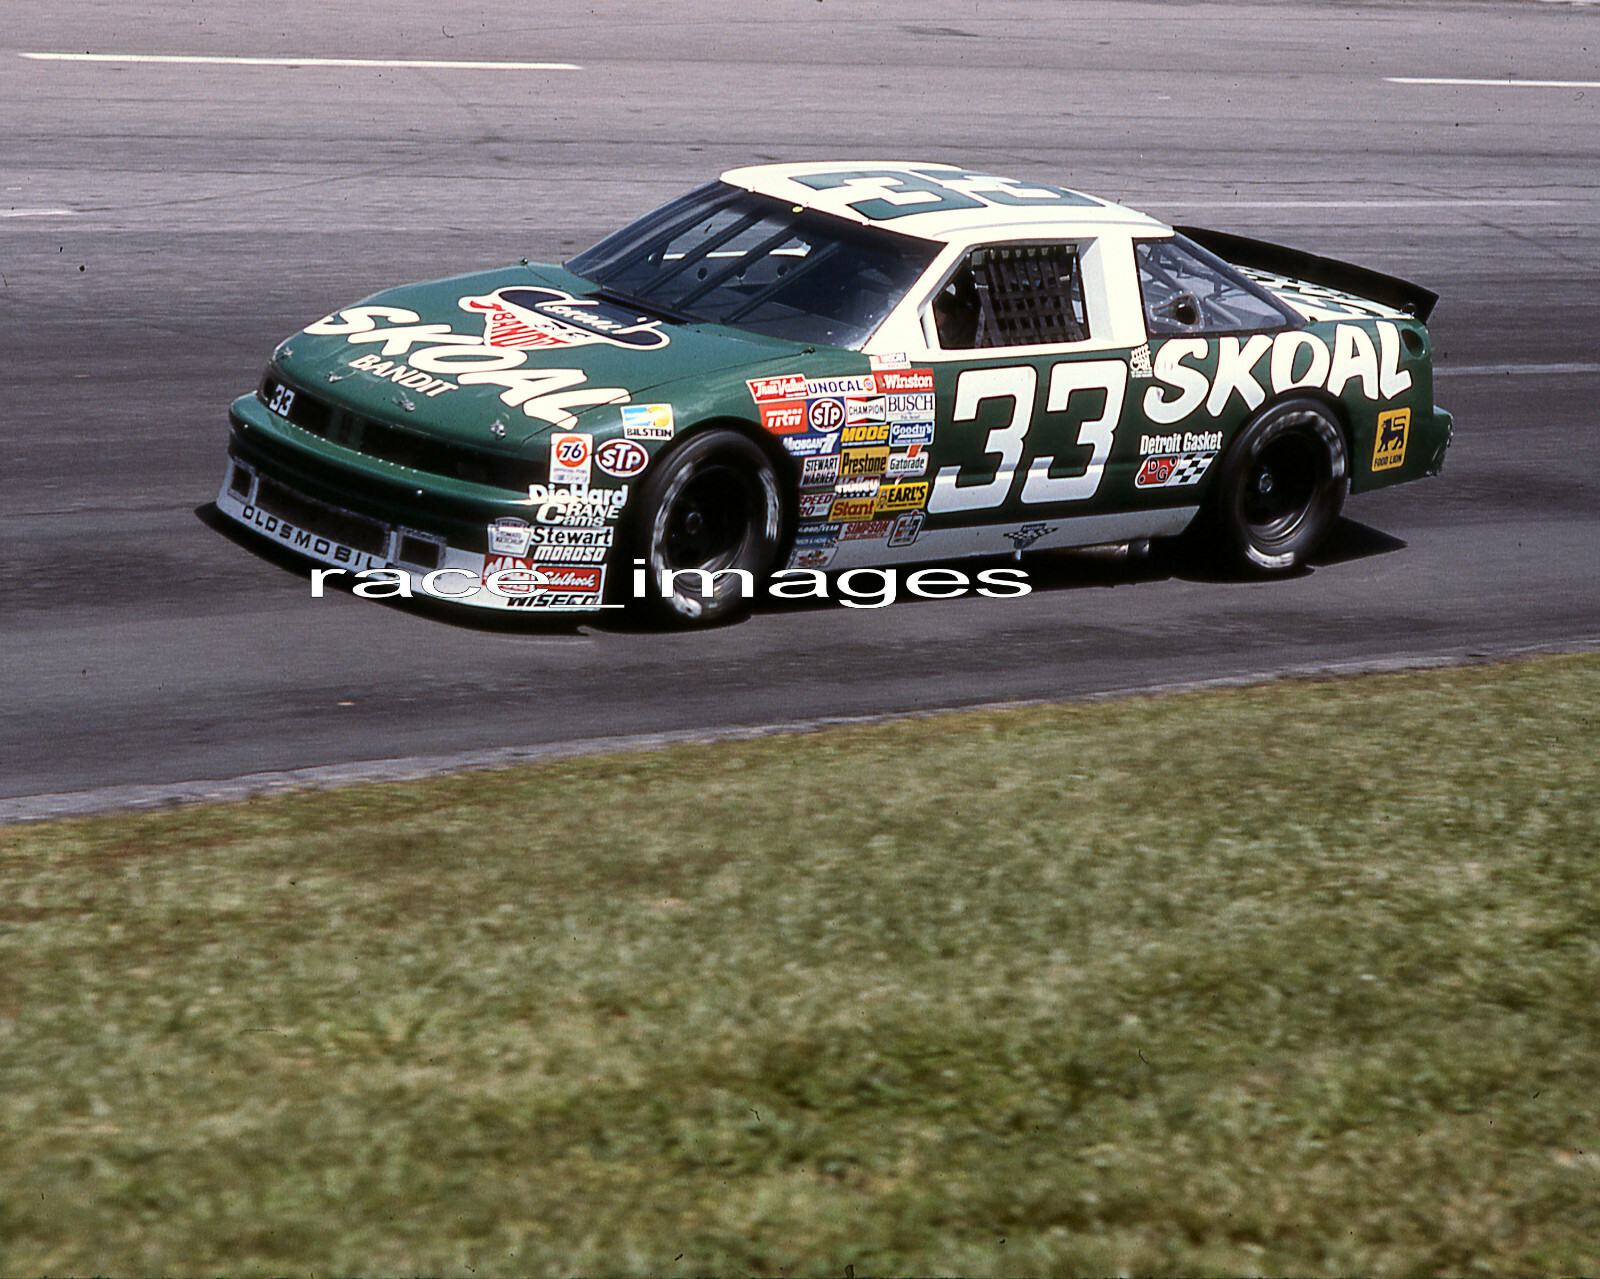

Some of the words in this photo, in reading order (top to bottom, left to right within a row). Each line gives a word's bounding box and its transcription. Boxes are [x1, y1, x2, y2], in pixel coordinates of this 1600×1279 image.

[788, 169, 1106, 221] 33
[303, 305, 632, 430] SKOAL
[348, 353, 460, 397] BANDIT
[1142, 321, 1413, 425] SKOAL
[807, 380, 864, 394] UNOCAL
[883, 373, 934, 389] Winston
[268, 383, 296, 417] 33
[888, 395, 934, 412] BUSCH
[765, 408, 803, 428] TRW
[813, 402, 841, 426] STP
[848, 404, 884, 416] CHAMPION
[626, 428, 672, 438] BILSTEIN
[841, 425, 890, 442] MOOG
[892, 423, 932, 437] Goody's
[926, 358, 1128, 514] 33
[559, 441, 584, 461] 76
[1139, 432, 1182, 455] Detroit
[1183, 430, 1223, 452] Gasket
[601, 443, 642, 470] STP
[805, 456, 839, 472] STEWART
[841, 453, 887, 474] Prestone
[889, 457, 925, 470] Gatorade
[802, 473, 836, 486] WARNER
[528, 483, 629, 506] DieHard
[799, 494, 834, 505] PEED
[887, 485, 927, 502] EARL'S
[832, 499, 875, 517] Stant
[531, 526, 612, 544] Stewart
[844, 520, 890, 535] SIMPSON
[242, 504, 402, 576] OLDSMOBIL
[533, 546, 607, 562] MOROSO
